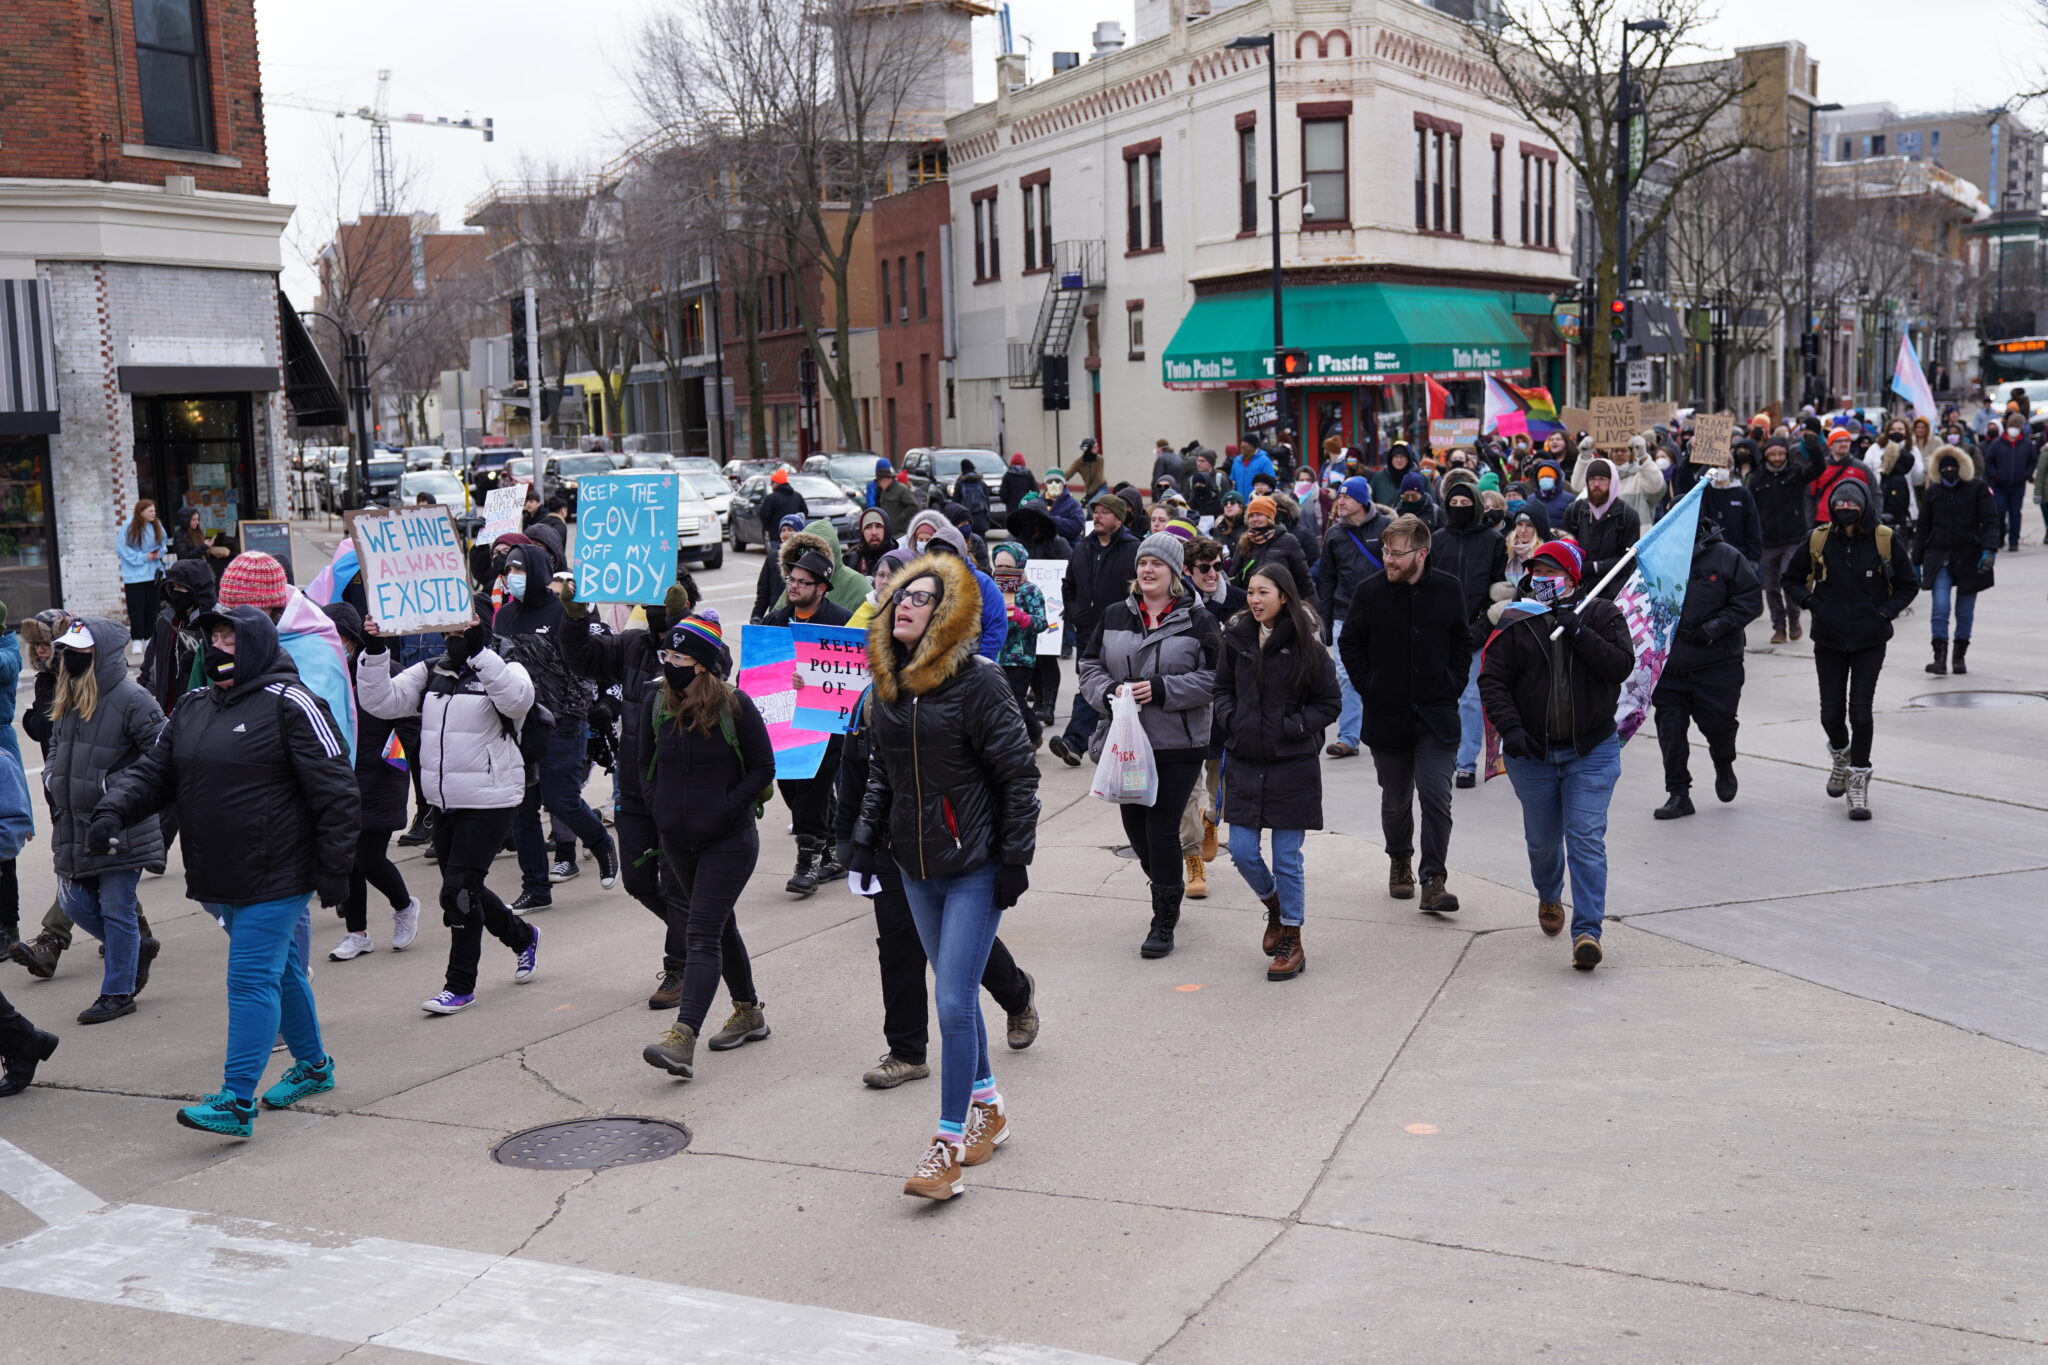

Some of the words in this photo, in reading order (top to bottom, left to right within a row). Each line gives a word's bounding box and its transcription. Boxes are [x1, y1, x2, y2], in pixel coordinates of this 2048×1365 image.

[1318, 354, 1369, 373] Pasta
[1374, 351, 1397, 361] State
[1165, 360, 1192, 379] Tutto
[1193, 359, 1220, 379] Pasta
[1374, 360, 1401, 370] Street
[1630, 363, 1648, 371] ONE
[1630, 372, 1648, 380] WAY
[1596, 401, 1634, 414] SAVE
[1592, 415, 1635, 428] TRANS
[1700, 417, 1729, 429] TRANS
[1596, 429, 1636, 444] LIVES
[1696, 424, 1725, 435] PEOPLE
[491, 487, 517, 502] TRANS
[580, 481, 619, 502] KEEP
[625, 483, 659, 504] THE
[484, 500, 511, 513] PEOPLE
[513, 497, 526, 509] ARE
[486, 508, 512, 522] LOVED
[582, 505, 665, 541] GOVT.
[361, 520, 401, 554] WE
[401, 516, 456, 550] HAVE
[581, 543, 614, 561] OFF
[625, 544, 651, 565] MY
[380, 551, 459, 580] ALWAYS
[581, 562, 666, 599] BODY
[1028, 567, 1064, 580] TECT
[376, 577, 471, 621] EXISTED
[819, 638, 865, 655] KEEP
[810, 658, 867, 676] POLIT
[838, 706, 849, 720] P
